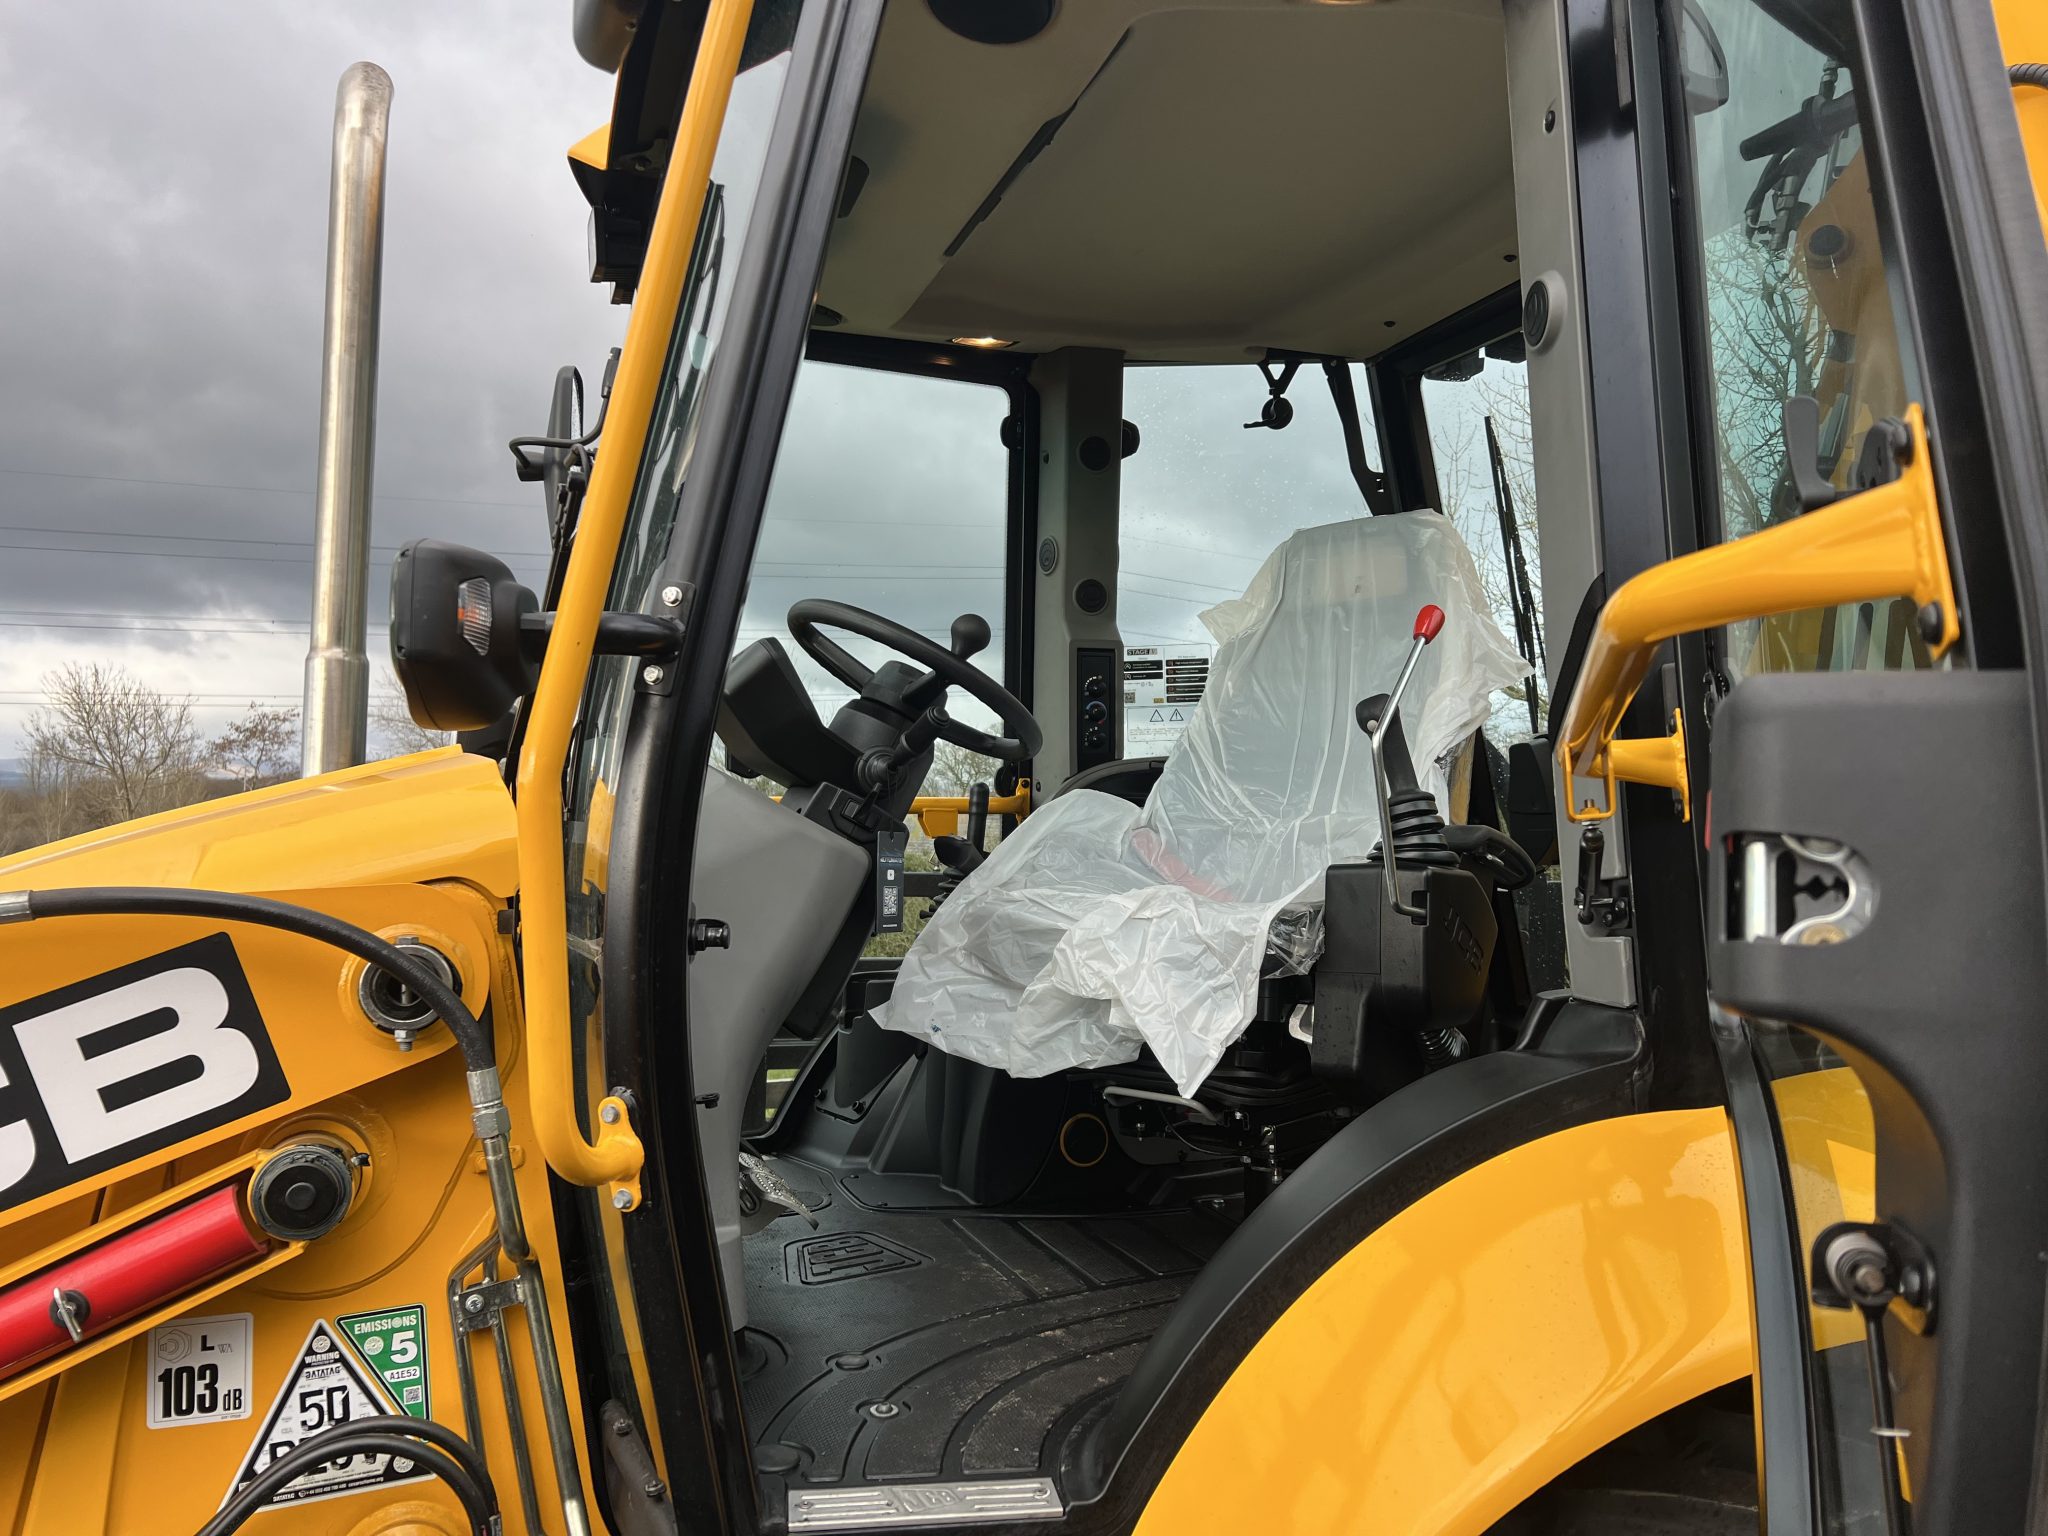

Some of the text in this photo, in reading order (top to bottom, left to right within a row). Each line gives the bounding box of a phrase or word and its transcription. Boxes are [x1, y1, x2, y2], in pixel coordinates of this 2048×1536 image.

[354, 1314, 417, 1335] EMISSIONS
[201, 1334, 215, 1352] L
[390, 1330, 418, 1364] 5
[304, 1350, 340, 1364] WARNING
[305, 1366, 342, 1379] DATATAG
[389, 1368, 418, 1381] A1E52
[158, 1363, 242, 1419] 103 dB
[899, 1488, 957, 1513] JCB
